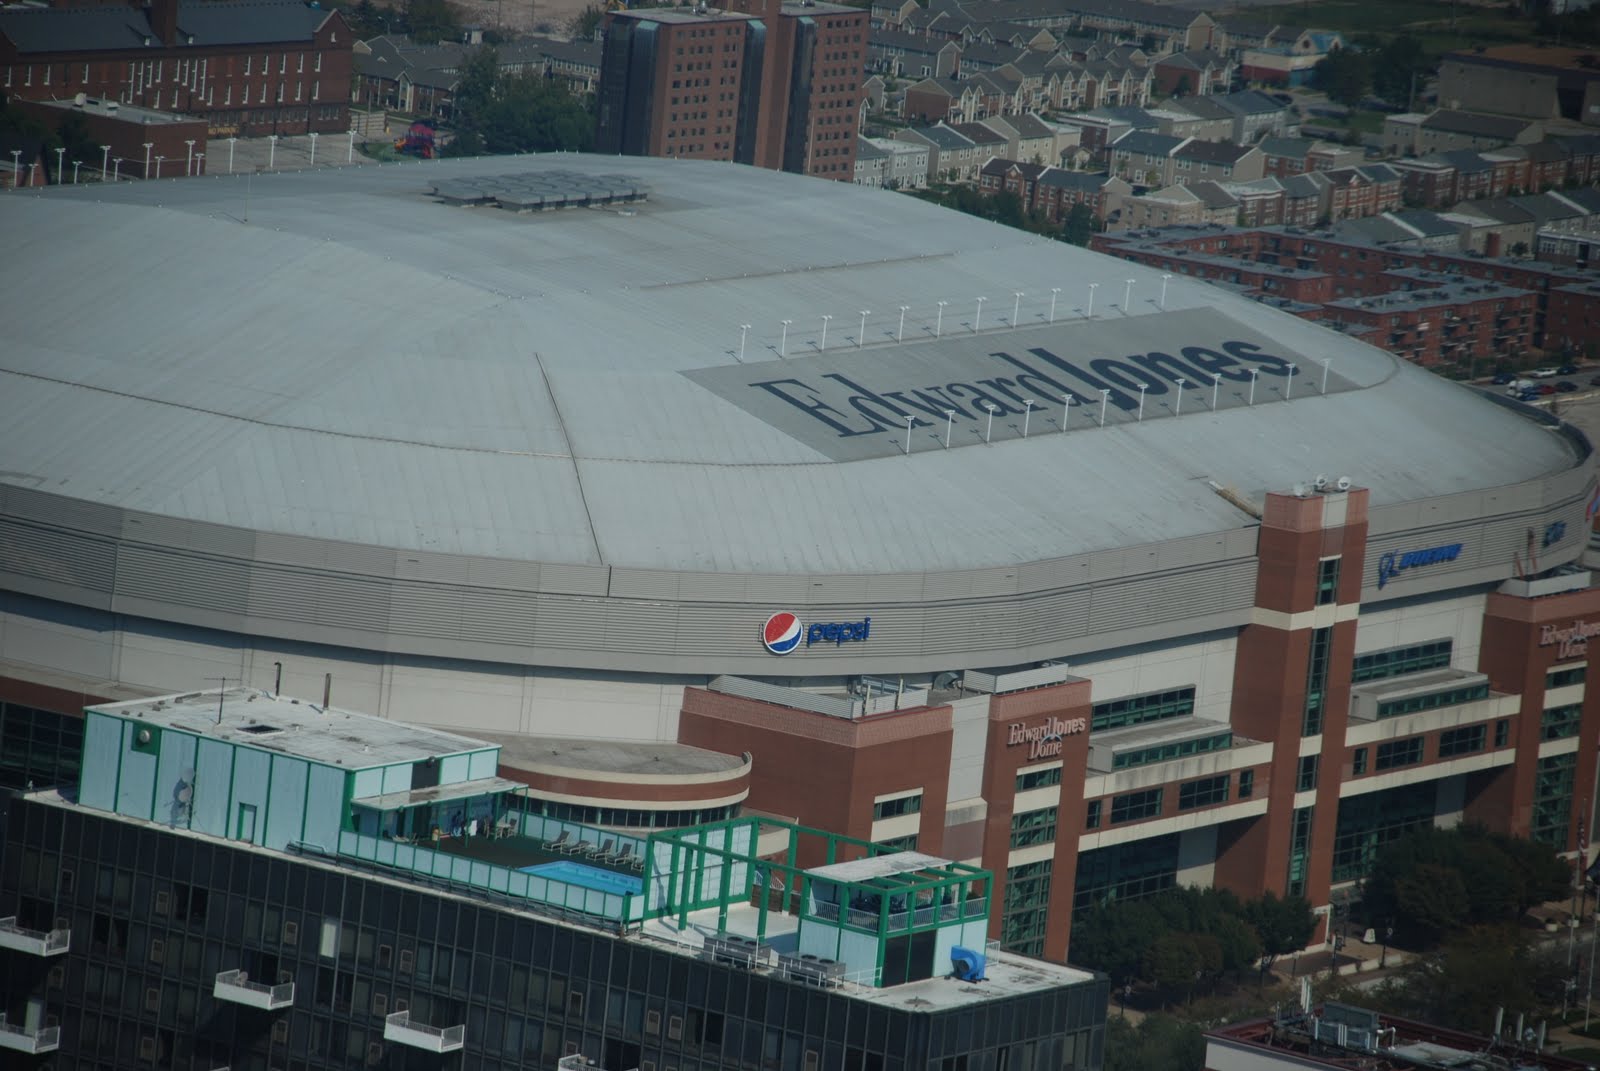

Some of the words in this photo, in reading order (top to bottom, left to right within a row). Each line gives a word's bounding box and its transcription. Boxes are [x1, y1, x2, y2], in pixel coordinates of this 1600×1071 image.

[749, 352, 1100, 437] Edward
[1028, 341, 1299, 410] Jones
[807, 616, 871, 648] pepsi
[1007, 717, 1052, 745] Edward
[1051, 716, 1086, 738] Jones
[1028, 740, 1062, 760] Dome
